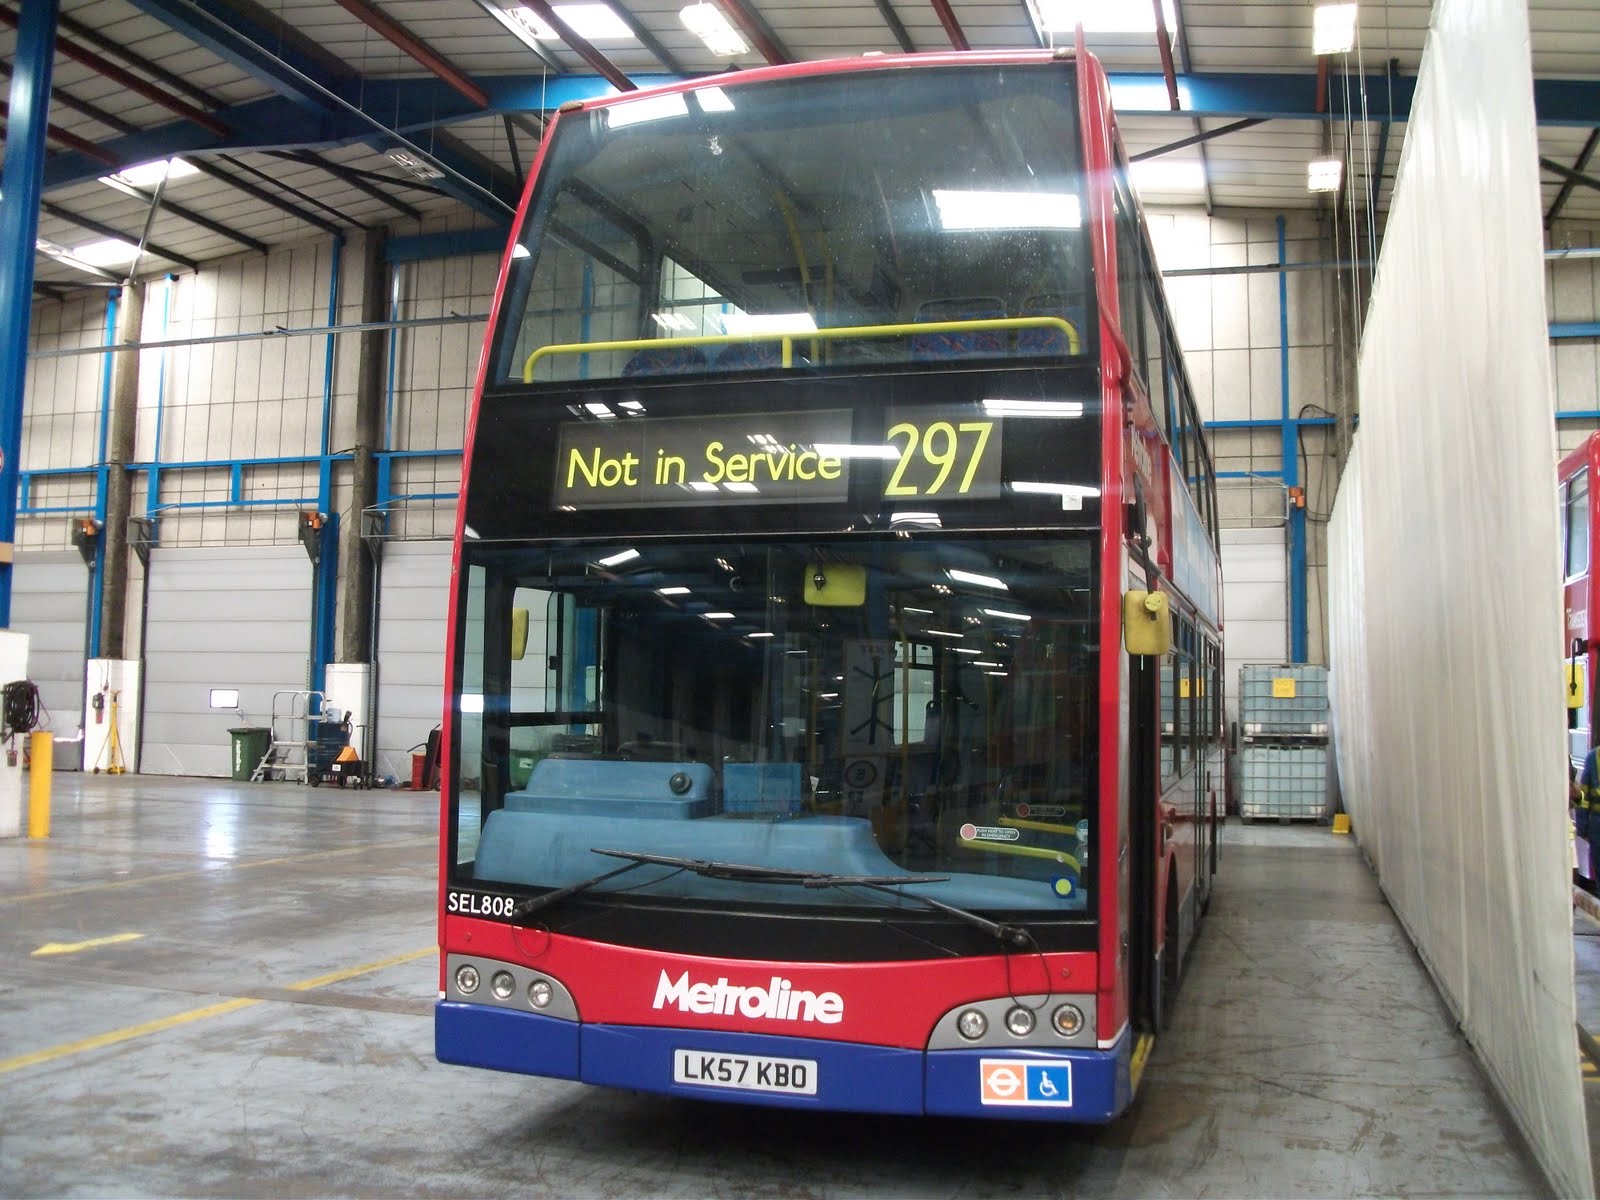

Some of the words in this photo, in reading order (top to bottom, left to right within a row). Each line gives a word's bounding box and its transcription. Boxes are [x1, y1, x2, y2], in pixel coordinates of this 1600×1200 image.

[566, 447, 639, 488] Not
[655, 448, 686, 485] in
[704, 441, 840, 483] Service
[886, 421, 992, 496] 297
[448, 892, 515, 917] SEL808
[653, 969, 844, 1024] Metroline
[684, 1055, 749, 1083] LK57
[757, 1061, 807, 1089] KBO
